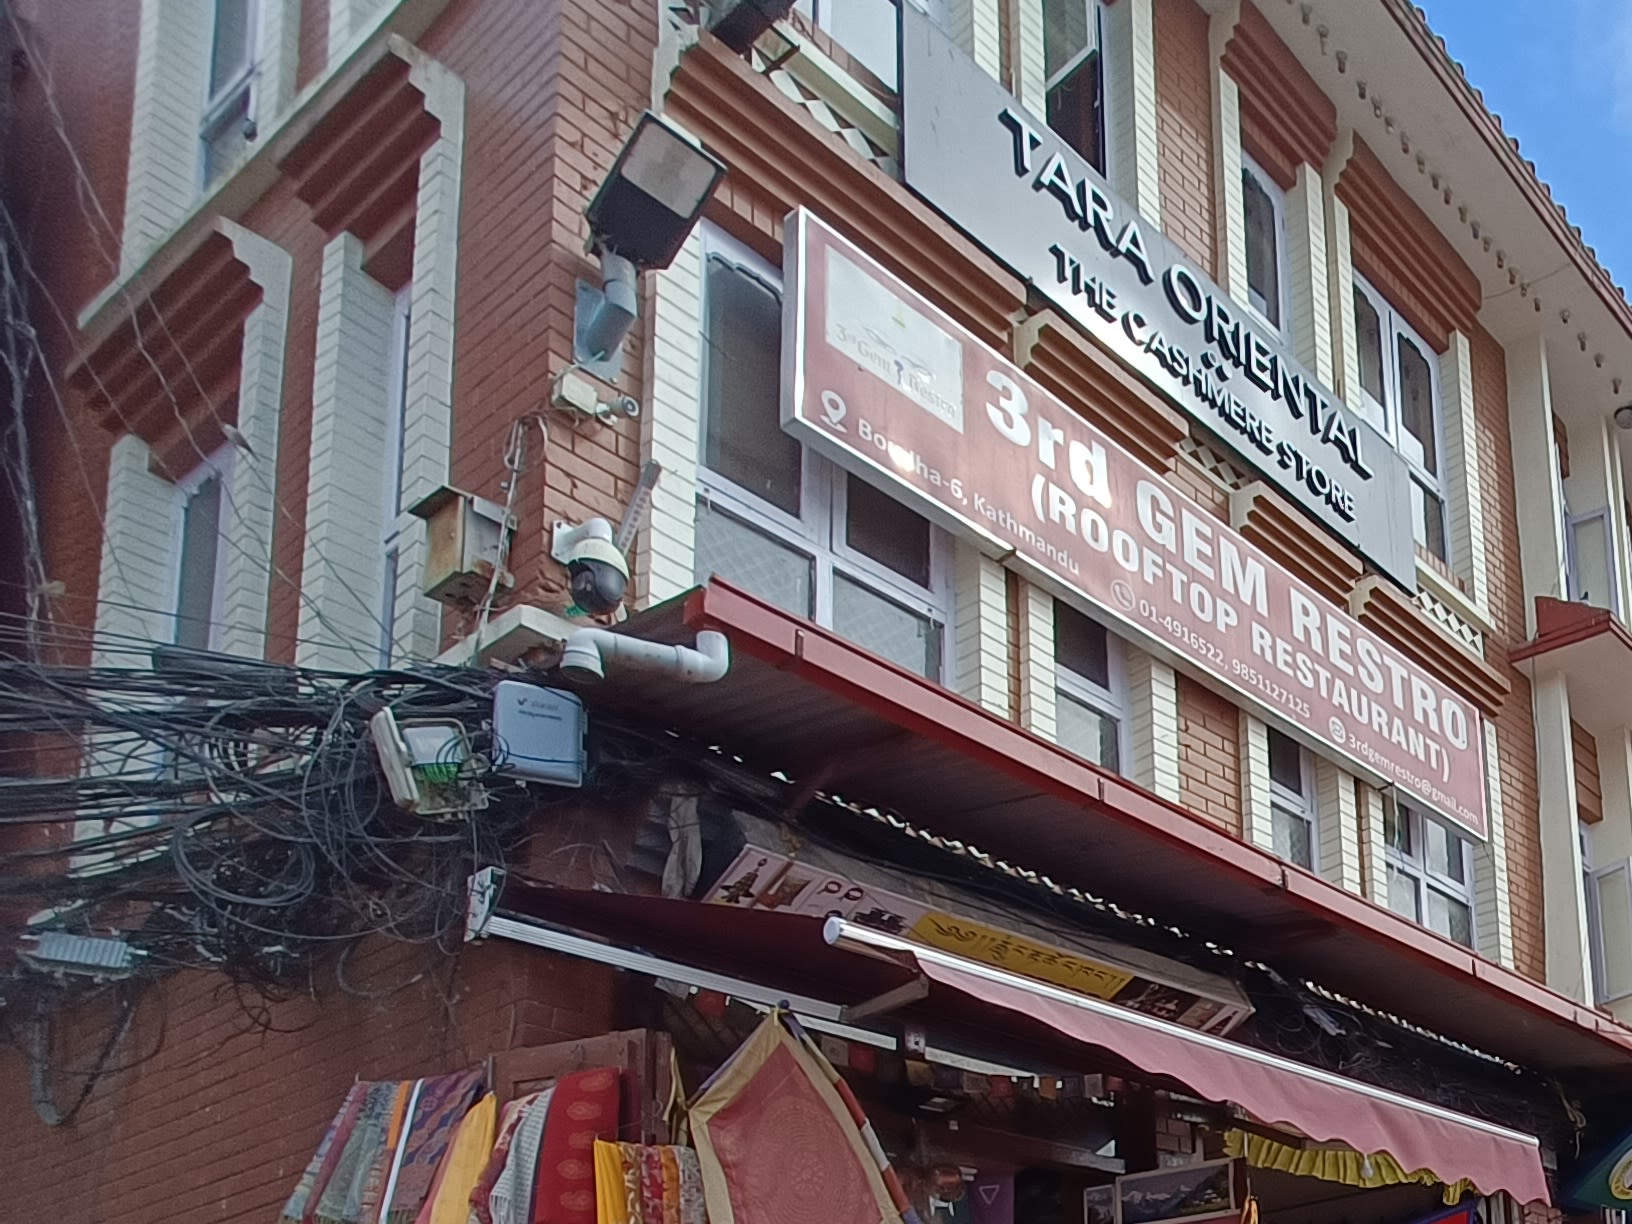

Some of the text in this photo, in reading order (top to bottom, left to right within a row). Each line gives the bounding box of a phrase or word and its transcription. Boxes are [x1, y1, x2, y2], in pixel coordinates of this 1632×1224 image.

[998, 107, 1374, 481] TARA ORIENTAL
[1048, 243, 1355, 523] THE CASHMERE STORE
[974, 493, 1080, 576] Kathmandu
[986, 369, 1468, 750] 3rd GEM RESTRO
[1031, 473, 1450, 784] (ROOFTOP RESTAURANT)
[1232, 658, 1312, 719] 9851127125
